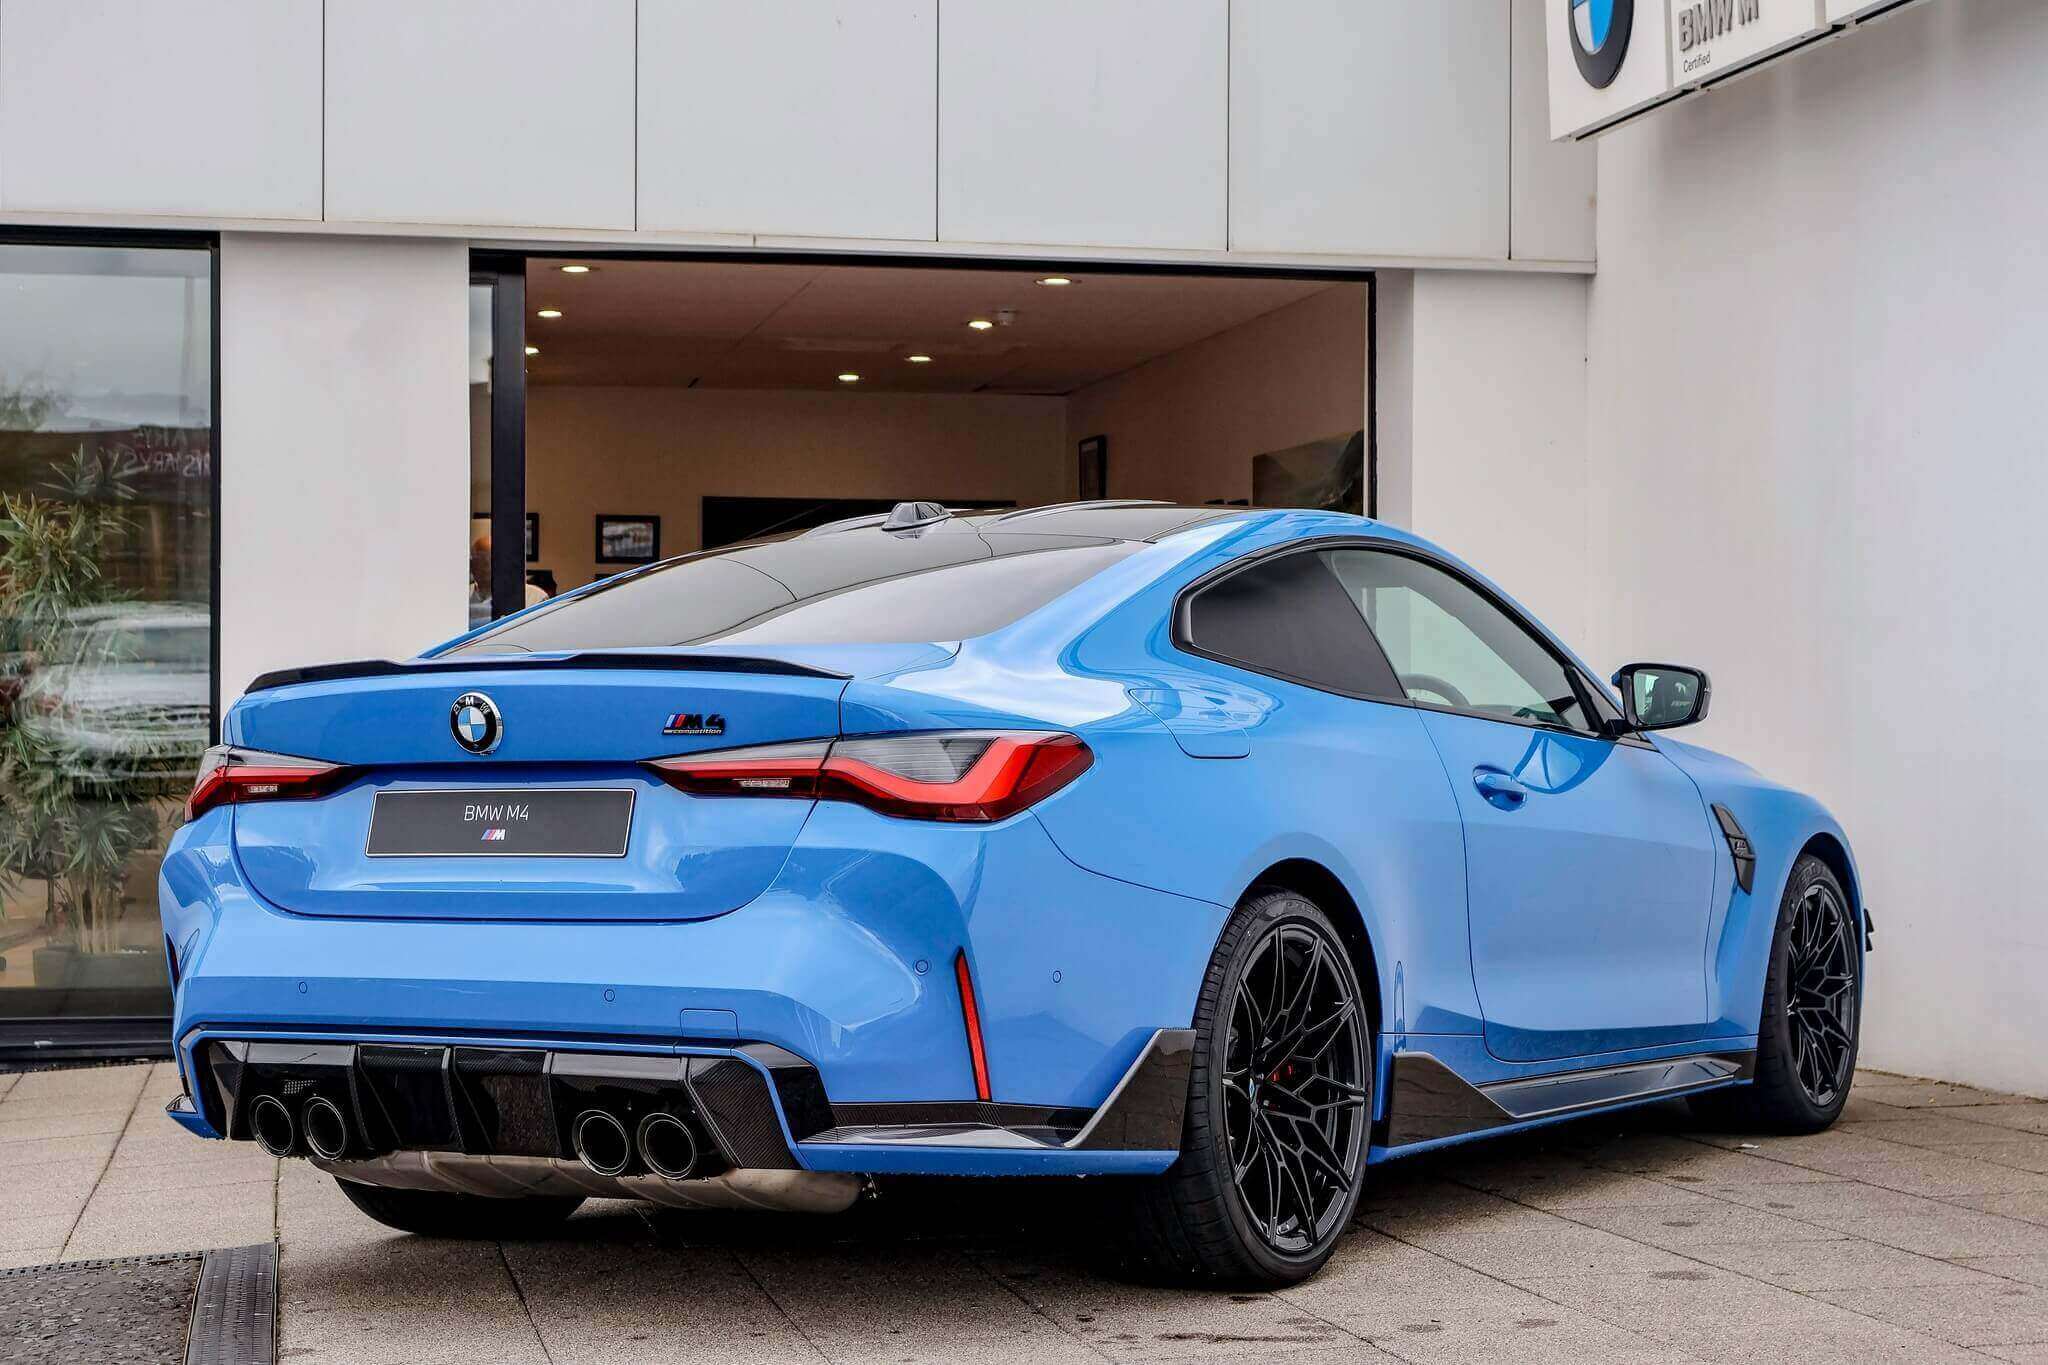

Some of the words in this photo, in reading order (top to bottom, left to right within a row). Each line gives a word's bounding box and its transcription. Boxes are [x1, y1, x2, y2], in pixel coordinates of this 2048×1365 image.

[1679, 0, 1733, 52] BMW
[1683, 51, 1711, 73] Certified
[463, 804, 504, 821] BMW
[506, 804, 529, 821] M4
